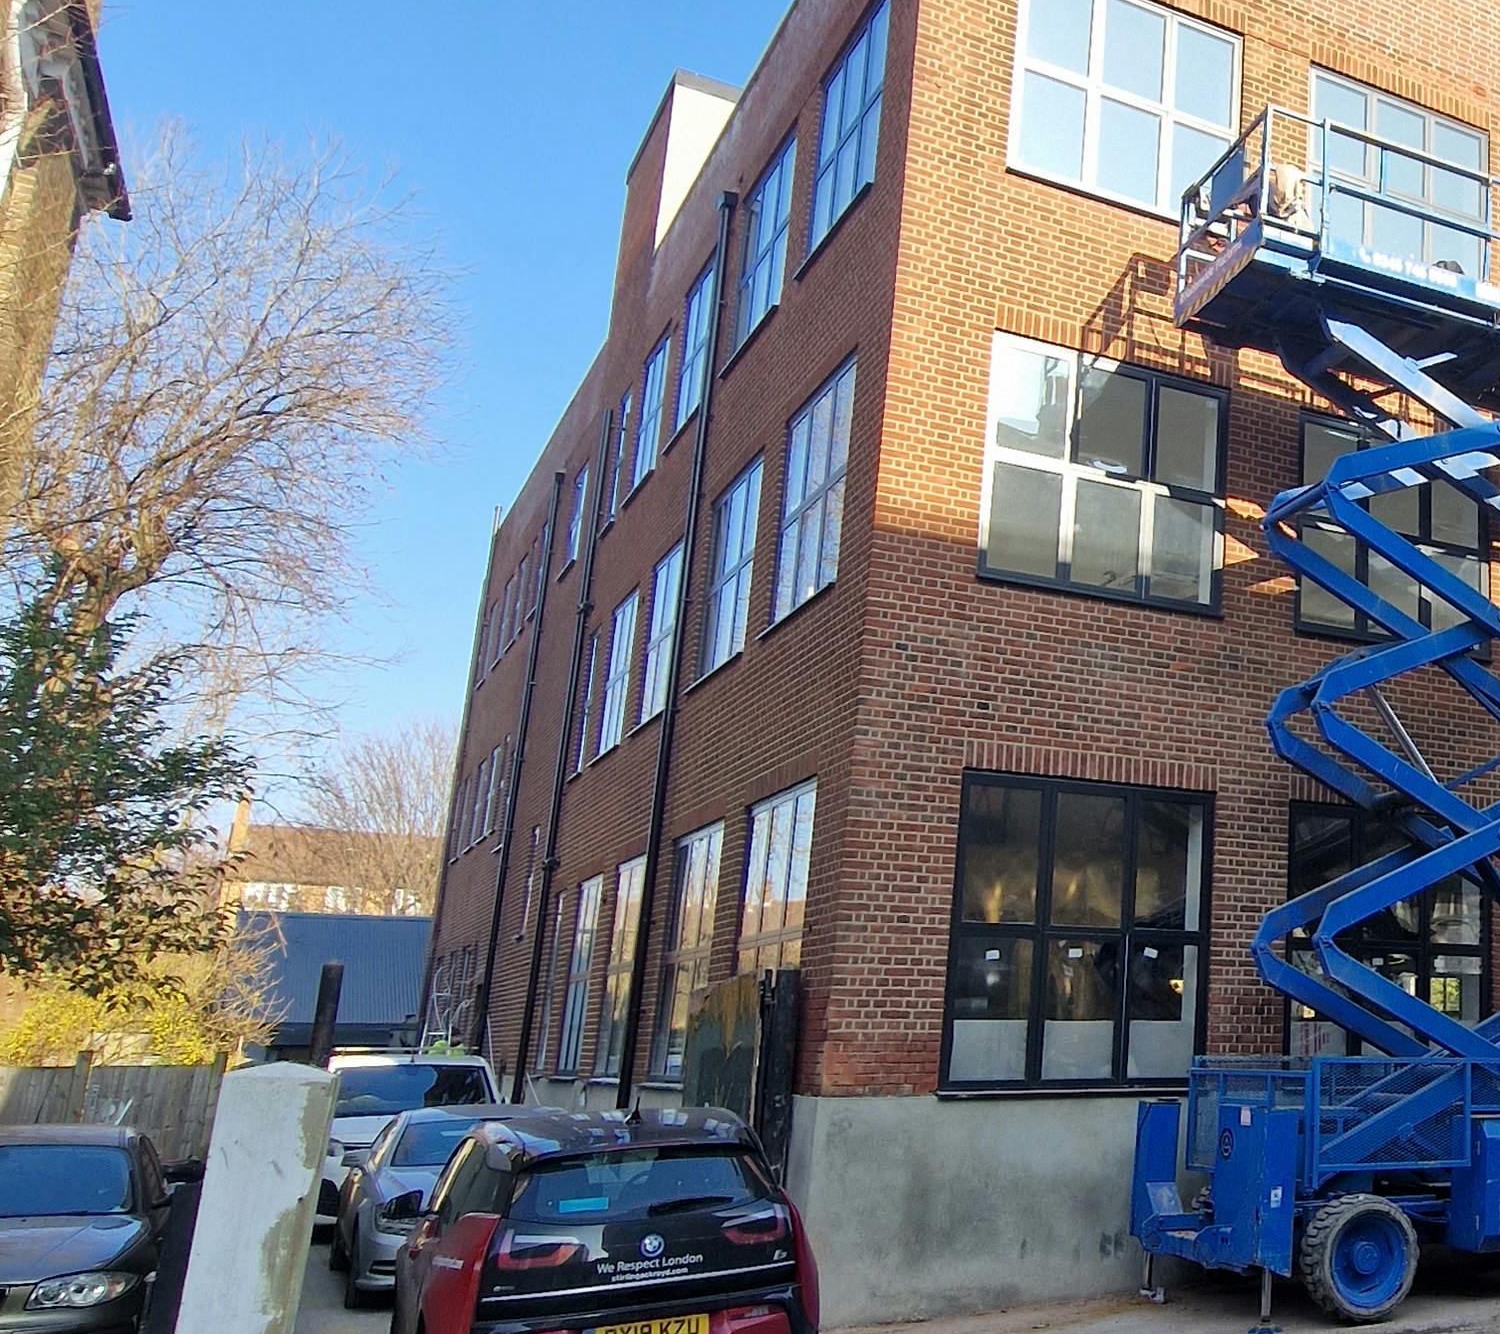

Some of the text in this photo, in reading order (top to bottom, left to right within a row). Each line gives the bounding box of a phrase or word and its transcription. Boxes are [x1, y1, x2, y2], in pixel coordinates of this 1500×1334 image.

[597, 1253, 704, 1274] We Respect London
